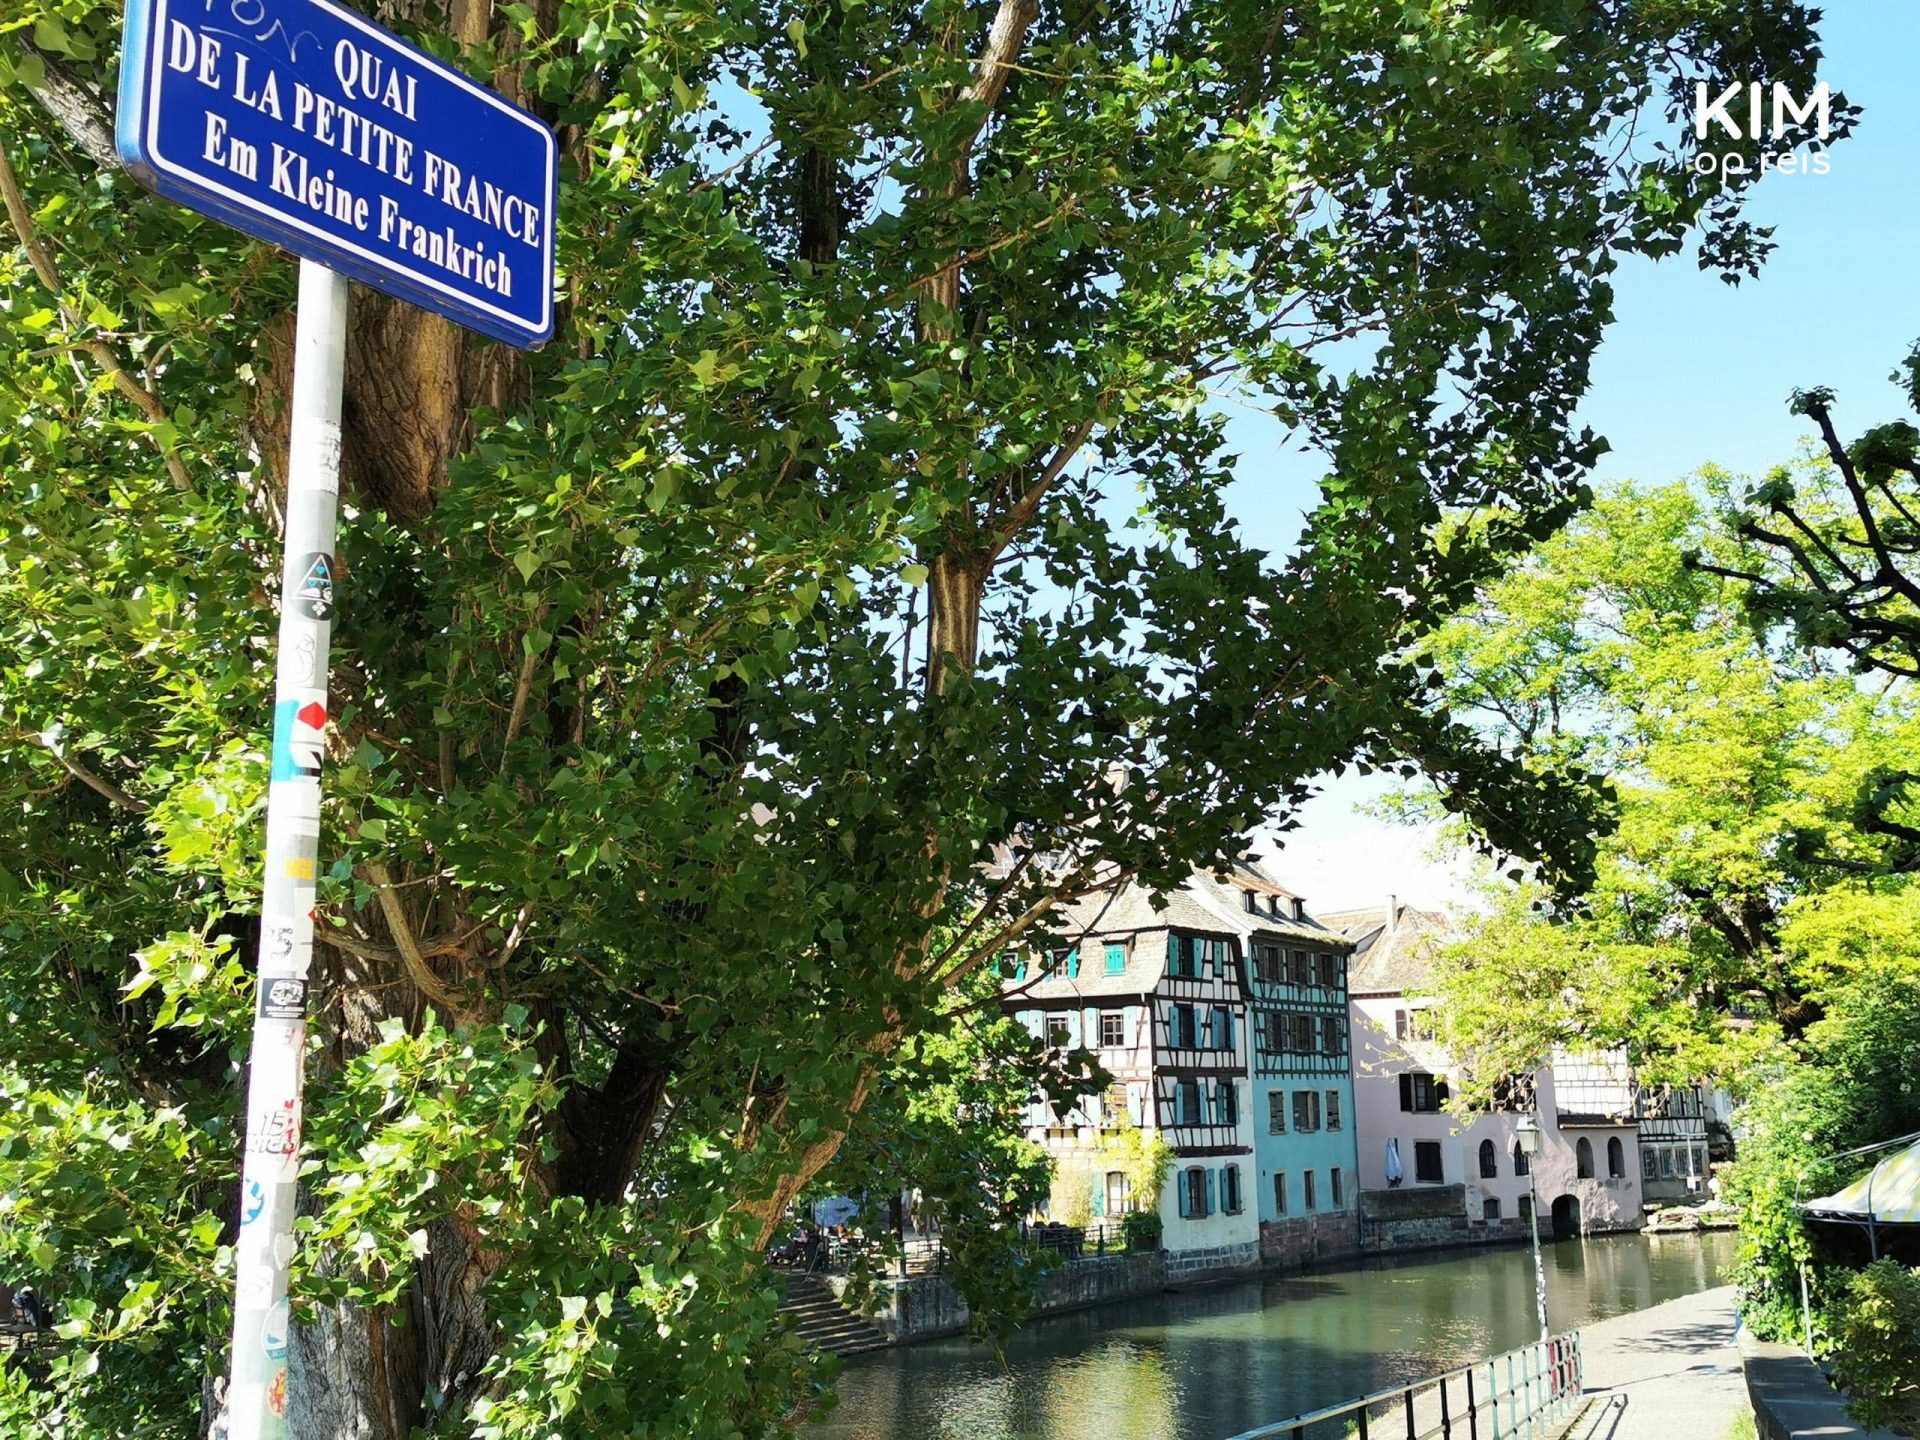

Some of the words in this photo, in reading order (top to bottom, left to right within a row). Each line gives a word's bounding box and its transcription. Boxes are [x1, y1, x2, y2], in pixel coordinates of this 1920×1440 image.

[168, 18, 221, 90] DE
[232, 52, 283, 121] LA
[292, 82, 413, 185] PETITE
[423, 150, 540, 248] FRANCE
[334, 38, 418, 122] QUAI
[203, 110, 258, 182] Em
[270, 142, 369, 231] Kleine
[378, 194, 512, 298] Frankrich
